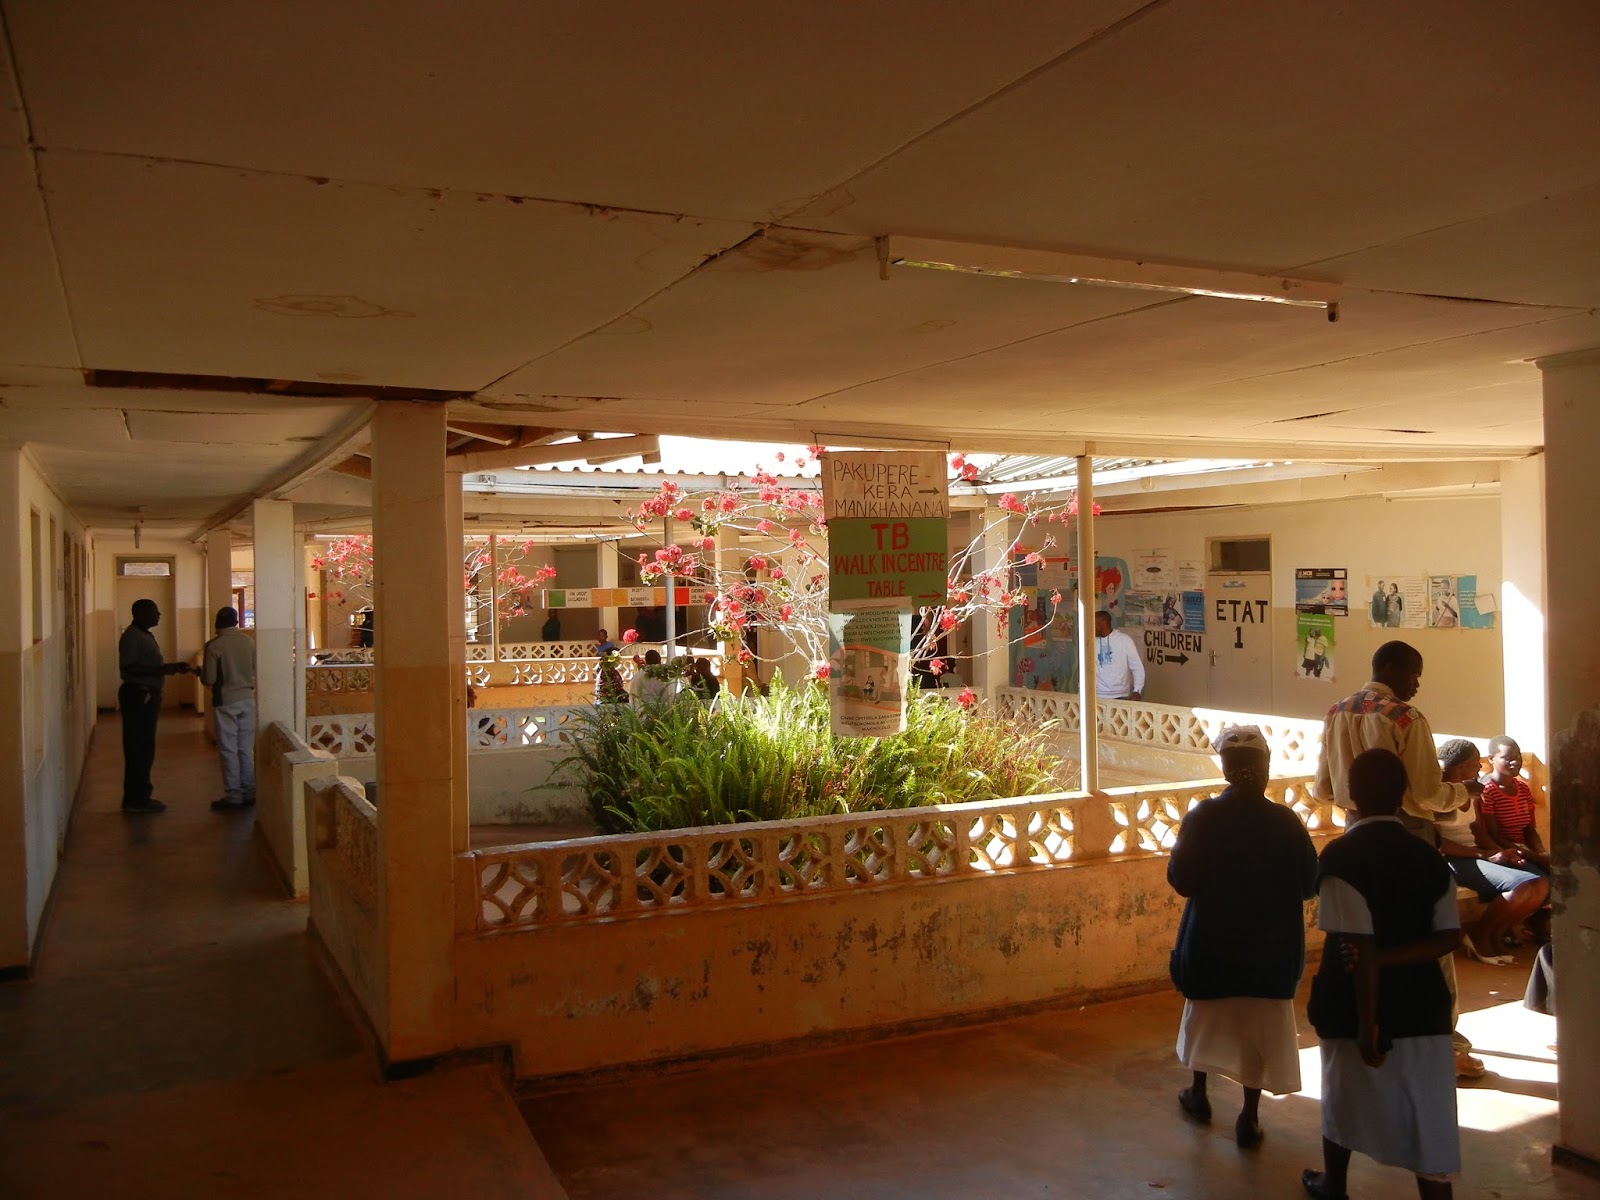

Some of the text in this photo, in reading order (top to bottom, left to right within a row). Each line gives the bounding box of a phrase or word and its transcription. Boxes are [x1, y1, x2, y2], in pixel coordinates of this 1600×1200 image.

[864, 484, 913, 500] KERA
[835, 499, 945, 517] MANKHANANA
[870, 522, 910, 551] TB
[834, 553, 878, 576] WALK
[897, 552, 945, 573] CENTRE
[867, 580, 906, 597] TABLE
[1216, 599, 1269, 623] ETAT
[1144, 630, 1202, 653] CHILDREN
[1234, 626, 1244, 649] 1
[1146, 648, 1164, 666] U/5
